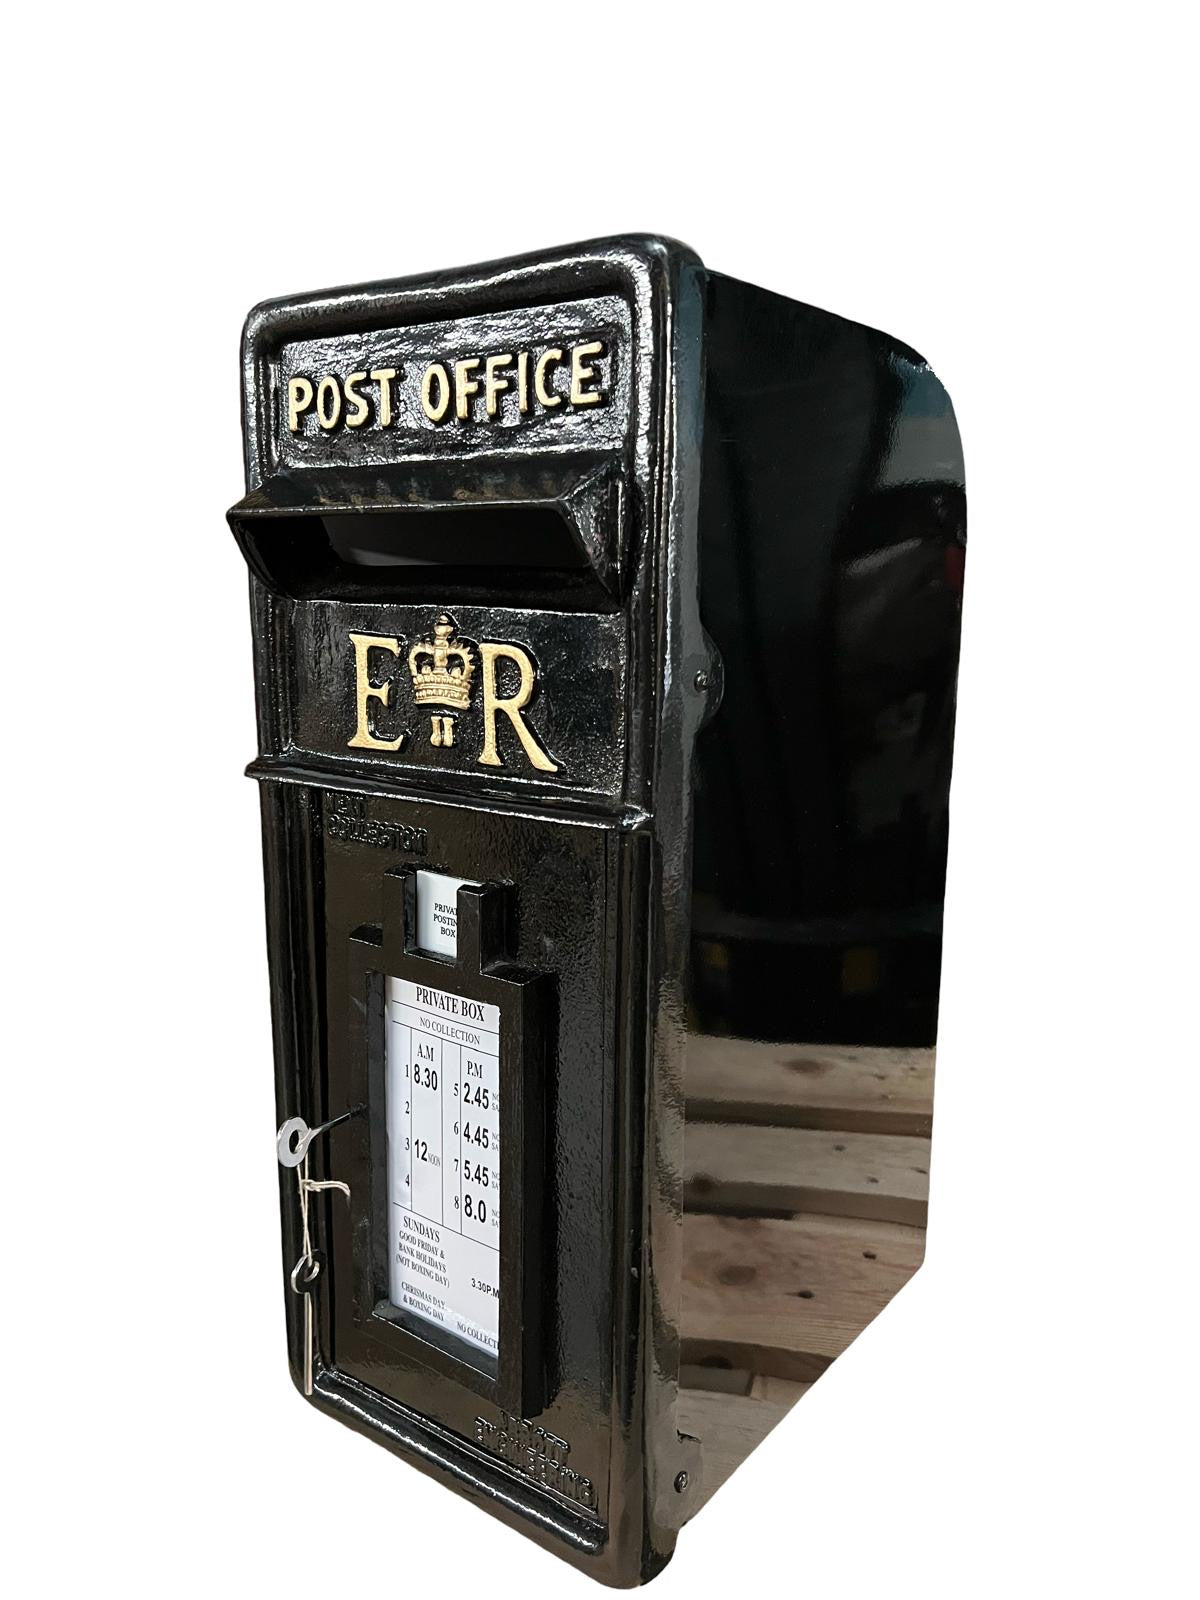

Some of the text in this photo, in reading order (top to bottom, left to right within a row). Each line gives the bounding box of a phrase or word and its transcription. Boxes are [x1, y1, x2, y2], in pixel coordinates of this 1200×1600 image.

[287, 341, 603, 432] POST OFFICE
[433, 913, 458, 927] POSTIN
[434, 902, 458, 916] PRIVAT
[440, 926, 456, 938] BOX
[415, 985, 485, 1022] PRIVATE BOX
[419, 1016, 481, 1046] NO COLLECTION
[416, 1043, 434, 1062] A.M
[405, 1063, 438, 1091] 1 8.30
[466, 1060, 483, 1079] P.M
[405, 1100, 410, 1115] 2
[453, 1082, 489, 1110] 5 2.45
[453, 1121, 489, 1149] 6 4.45
[404, 1137, 410, 1151] 3
[414, 1138, 428, 1162] 12
[405, 1173, 410, 1187] 4
[454, 1158, 489, 1187] 7 5.45
[454, 1194, 487, 1224] 8 8.0
[403, 1215, 440, 1243] SUNDAYS
[398, 1241, 447, 1273] BANK HOLIDAYS
[399, 1230, 445, 1260] GOOD FRIDAY &
[411, 1261, 434, 1280] BOXING
[434, 1272, 450, 1288] DAY)
[402, 1294, 445, 1321] & BOXING DAY
[456, 1320, 467, 1333] NO
